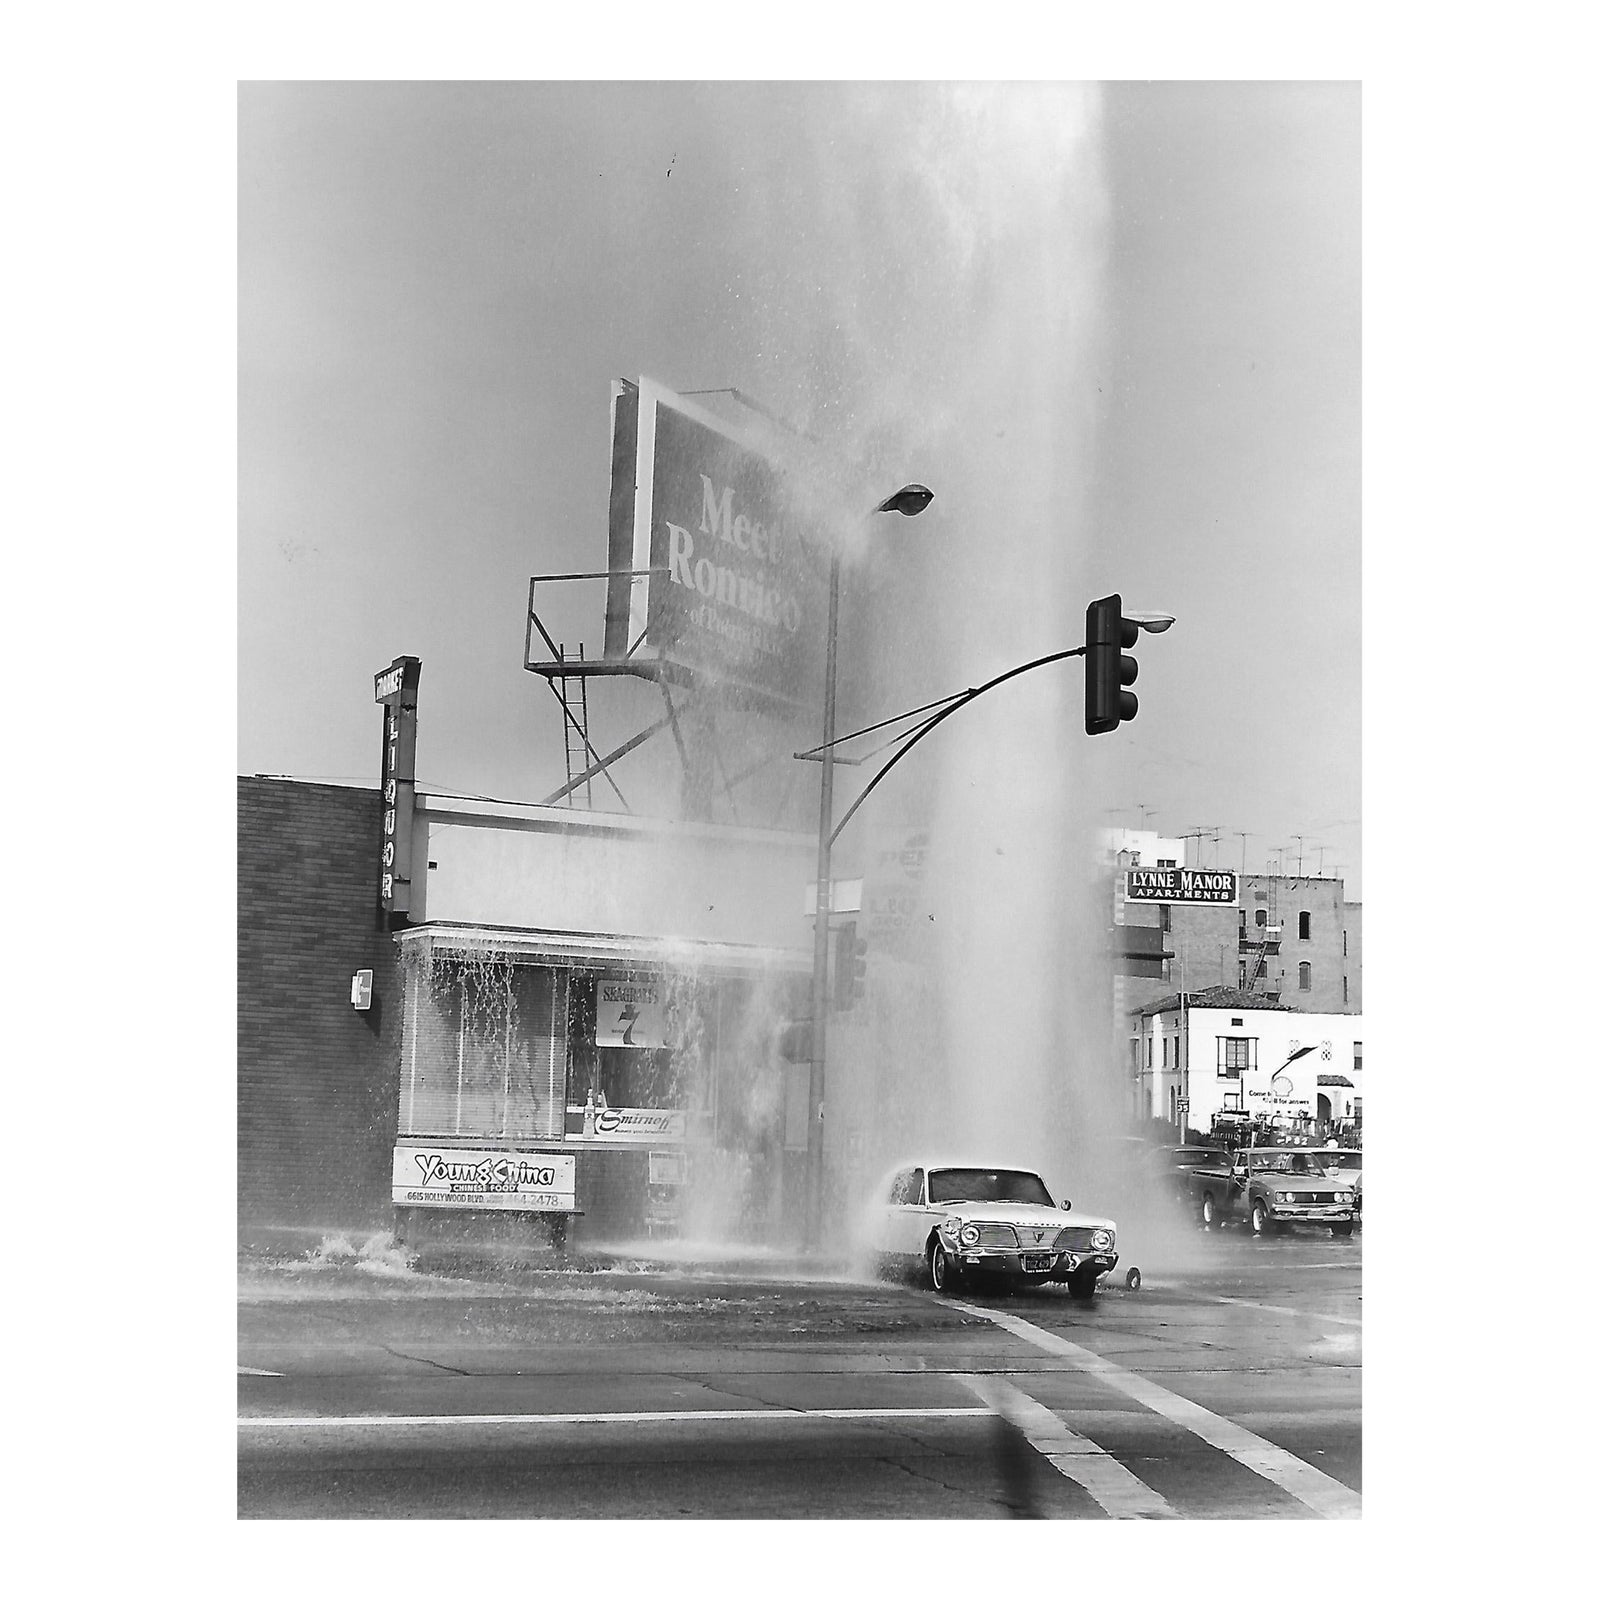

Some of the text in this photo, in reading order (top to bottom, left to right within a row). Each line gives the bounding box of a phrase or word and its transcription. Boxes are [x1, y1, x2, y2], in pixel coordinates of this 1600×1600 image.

[699, 473, 783, 564] Meet
[382, 715, 398, 899] LIQUOR
[1132, 871, 1232, 891] LYNNE MANOR
[1136, 888, 1229, 900] APARTMENTS
[617, 1006, 641, 1046] 7
[414, 1154, 555, 1186] Young China
[424, 1192, 467, 1203] HOLLYWOOD
[453, 1184, 516, 1192] CHINESE FOOD
